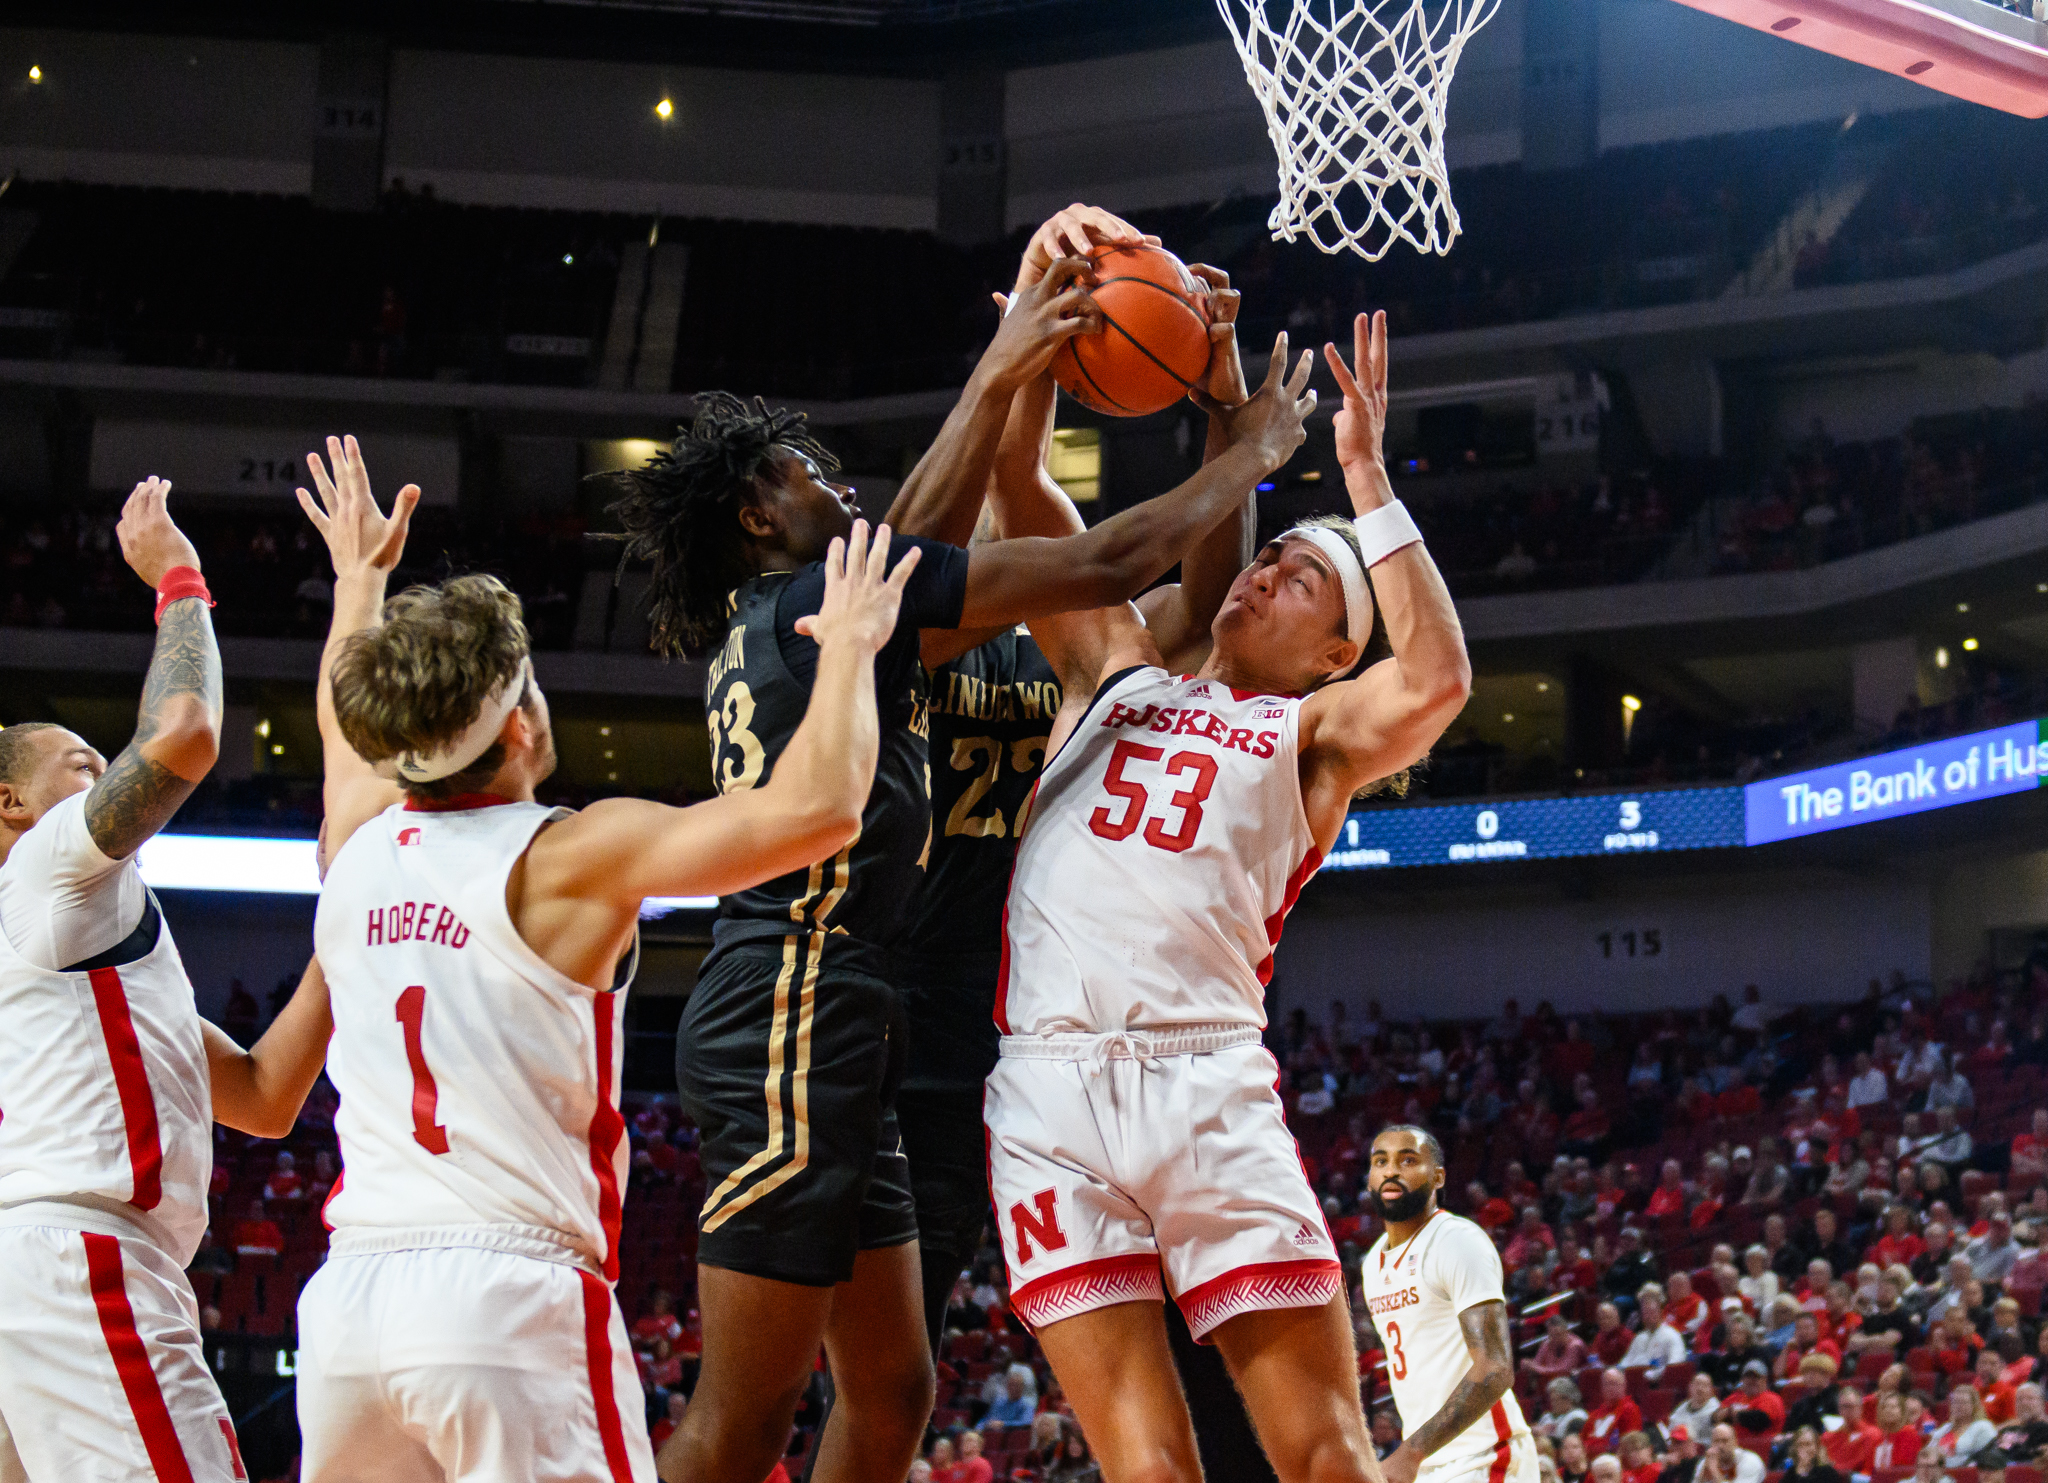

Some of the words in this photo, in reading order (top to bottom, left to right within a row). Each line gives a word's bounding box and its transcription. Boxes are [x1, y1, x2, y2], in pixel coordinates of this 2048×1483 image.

[239, 459, 296, 481] 214
[1100, 702, 1279, 760] HUSKERS
[1088, 739, 1219, 853] 53
[1781, 783, 1844, 825] The
[1851, 757, 1937, 812] Bank
[1943, 746, 1980, 791] of
[1597, 930, 1661, 958] 115
[395, 986, 451, 1155] 1
[1010, 1185, 1070, 1268] N
[1387, 1321, 1408, 1381] 3
